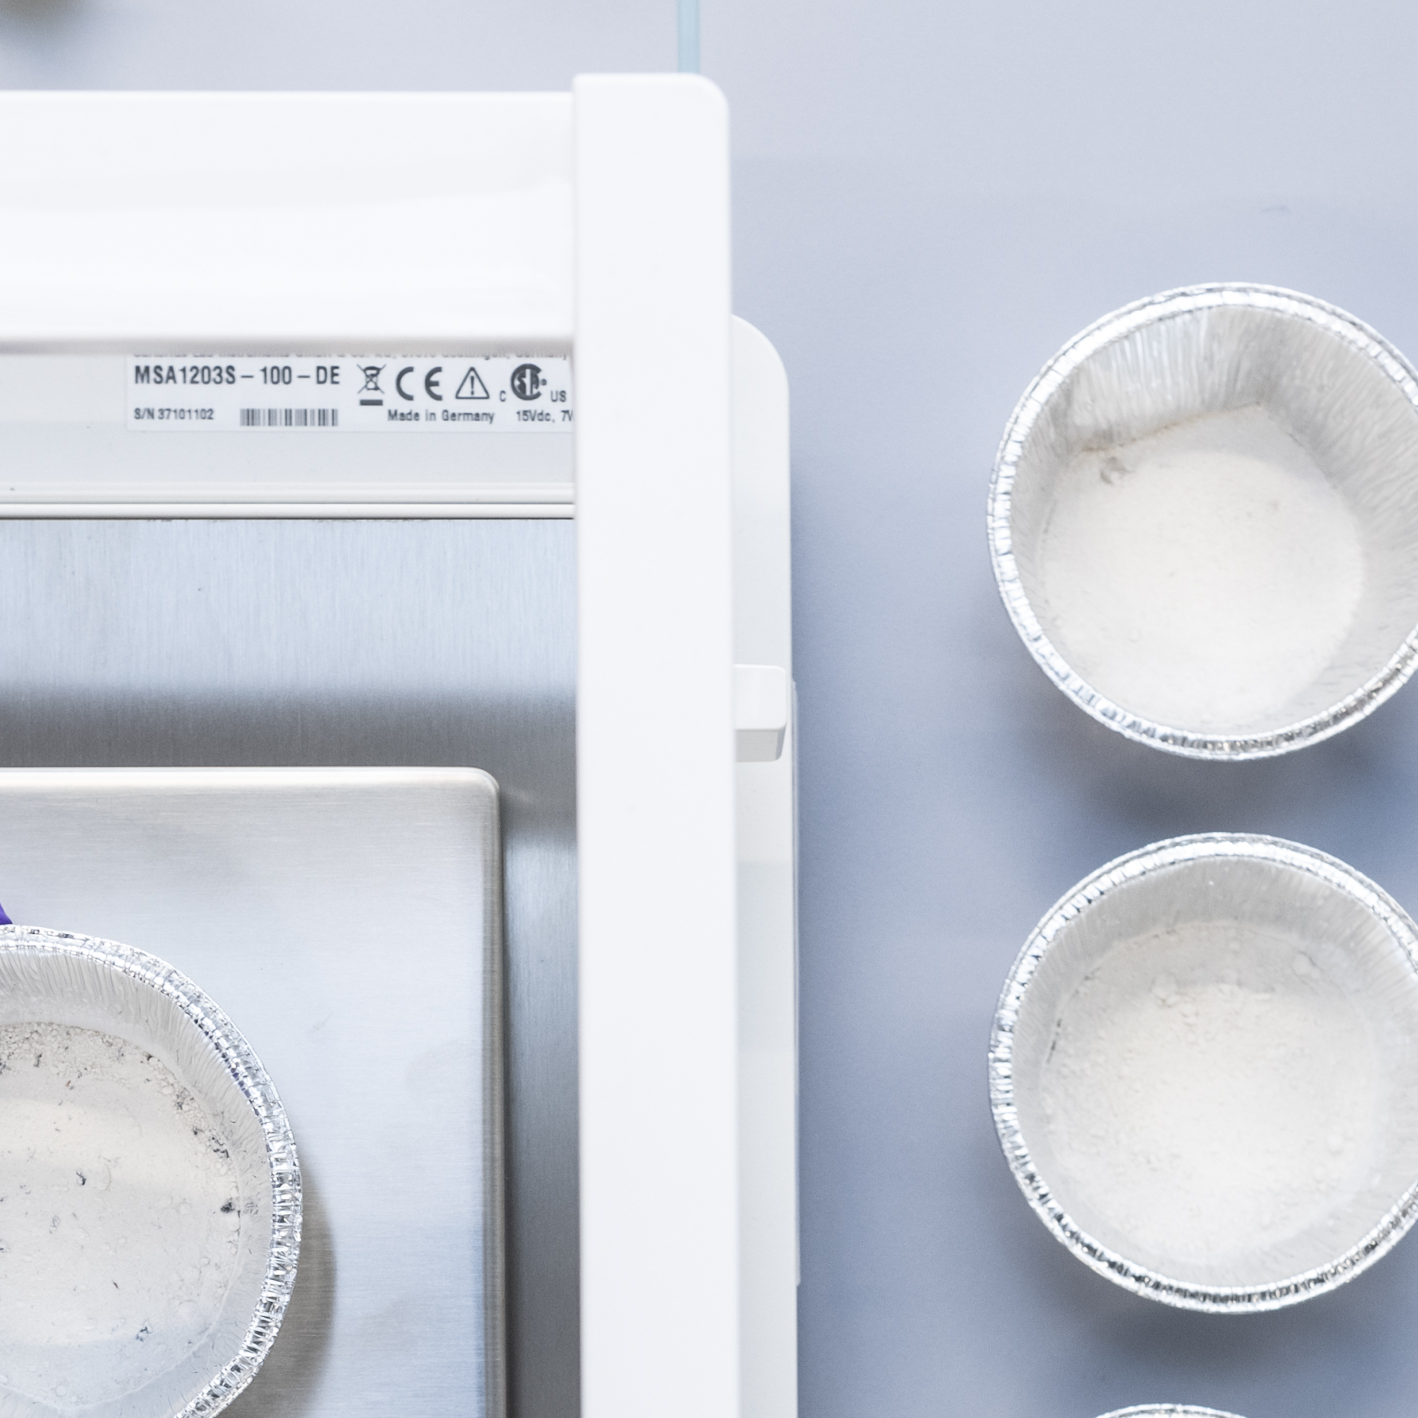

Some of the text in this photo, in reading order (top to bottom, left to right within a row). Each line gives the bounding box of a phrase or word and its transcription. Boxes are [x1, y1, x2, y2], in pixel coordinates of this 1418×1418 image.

[134, 408, 214, 420] S/N 37101102
[387, 409, 495, 424] Made in Germany
